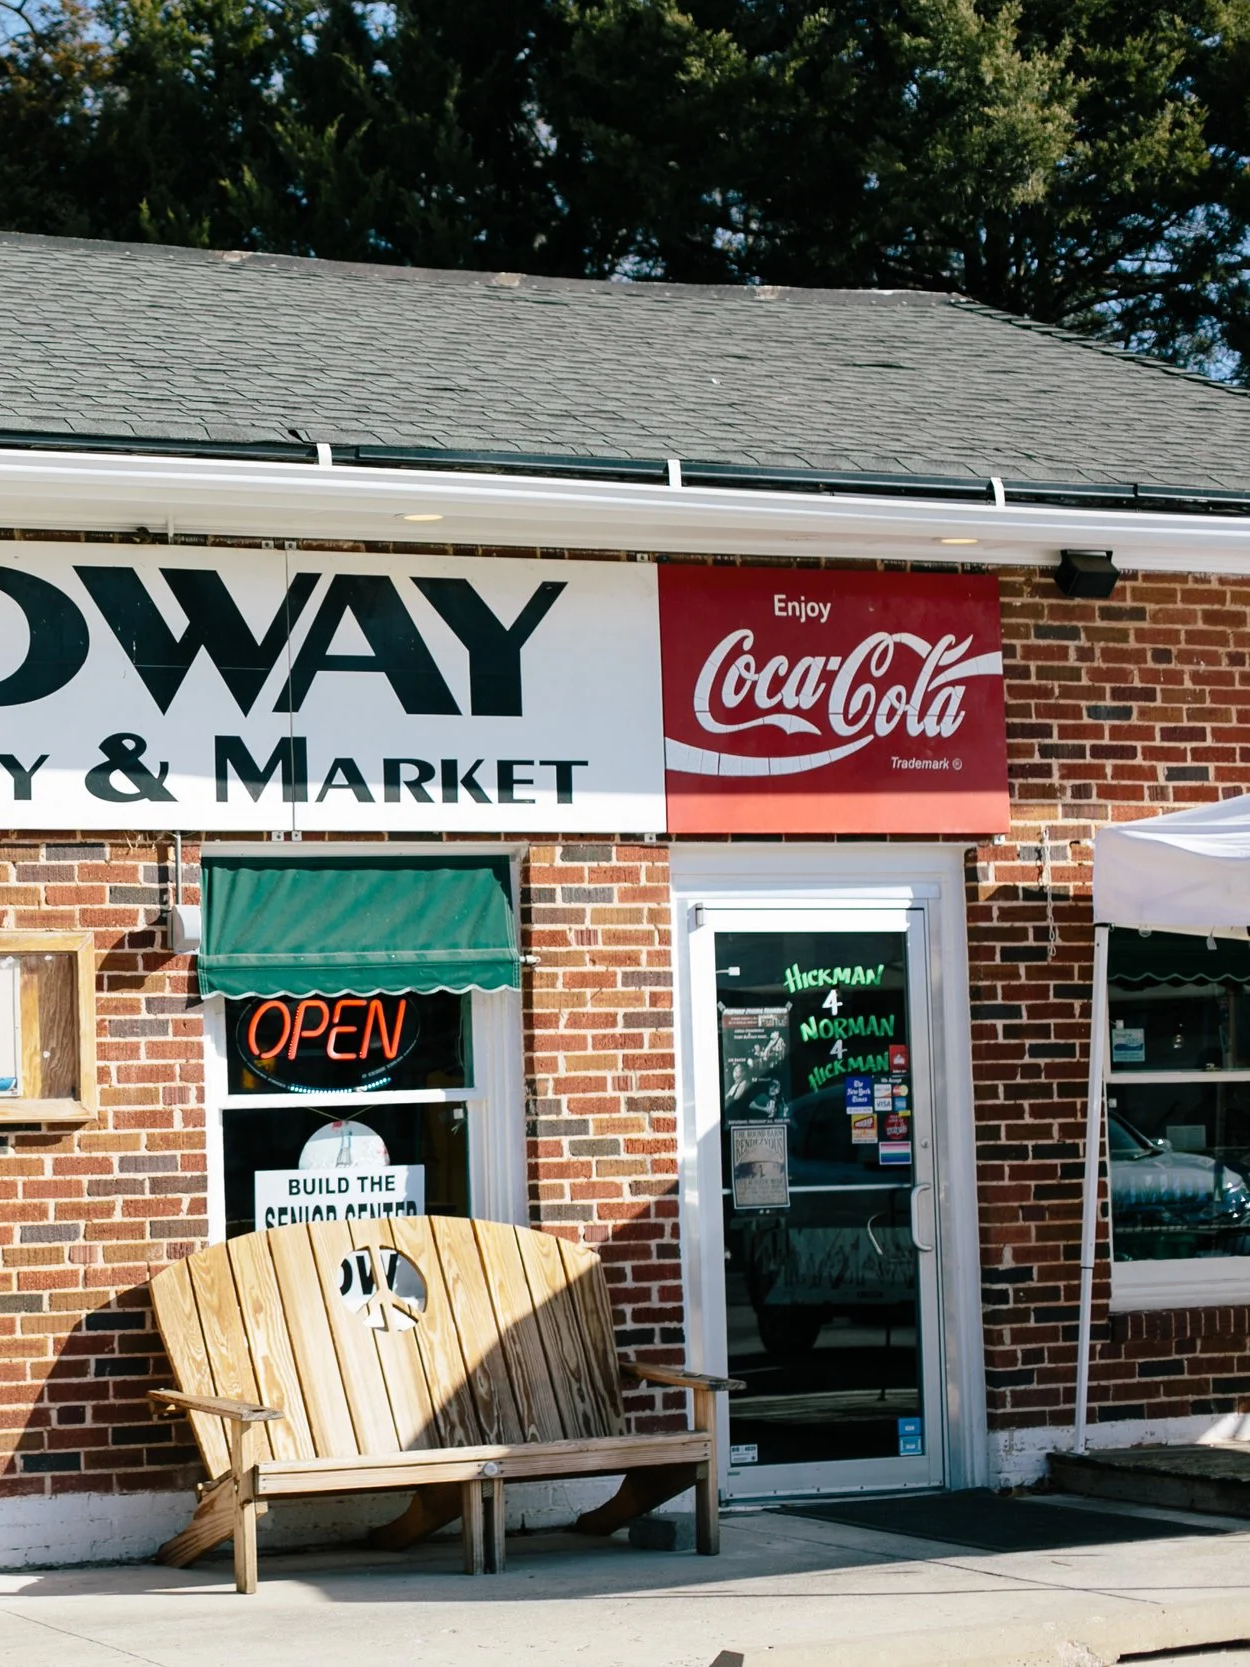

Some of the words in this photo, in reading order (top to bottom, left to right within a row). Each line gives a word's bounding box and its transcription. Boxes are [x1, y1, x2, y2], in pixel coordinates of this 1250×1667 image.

[774, 594, 831, 623] Enjoy
[693, 628, 974, 738] Coca-Cola
[84, 732, 180, 804] &
[215, 735, 589, 806] MARKET
[891, 756, 950, 770] Trademark
[783, 963, 884, 993] HICKMAN
[822, 989, 843, 1016] 4
[248, 999, 407, 1061] OPEN
[800, 1014, 895, 1042] NORMAN
[830, 1039, 848, 1059] 4
[808, 1051, 890, 1093] HICKMAN
[288, 1177, 349, 1196] BUILD
[357, 1175, 396, 1193] THE
